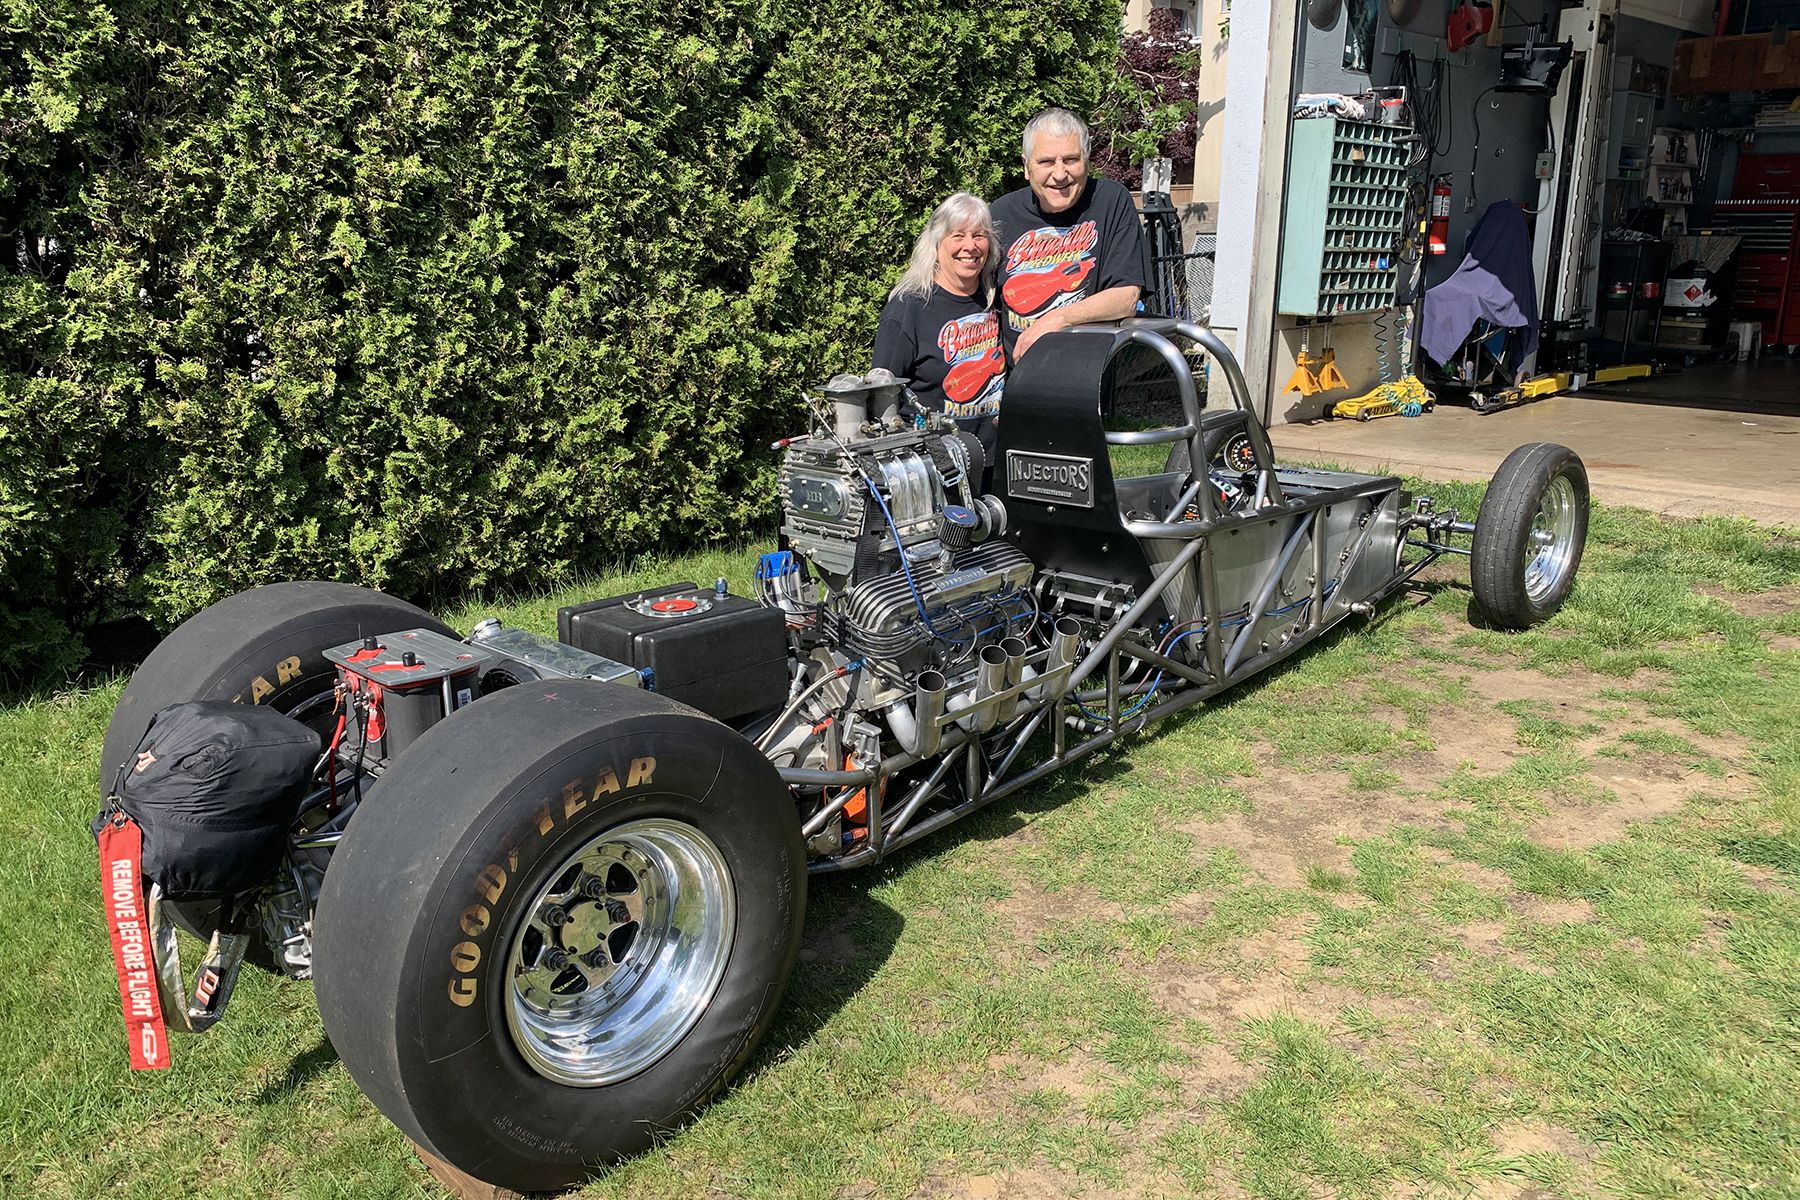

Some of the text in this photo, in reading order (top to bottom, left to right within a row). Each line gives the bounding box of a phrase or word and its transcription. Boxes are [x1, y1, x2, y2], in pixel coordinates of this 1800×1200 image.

[957, 337, 999, 360] SPEEDWEE
[944, 400, 1000, 417] PARTICIPA
[1010, 456, 1089, 491] INJECTORS
[111, 858, 153, 1017] REMOVE BEFORE FLIGHT
